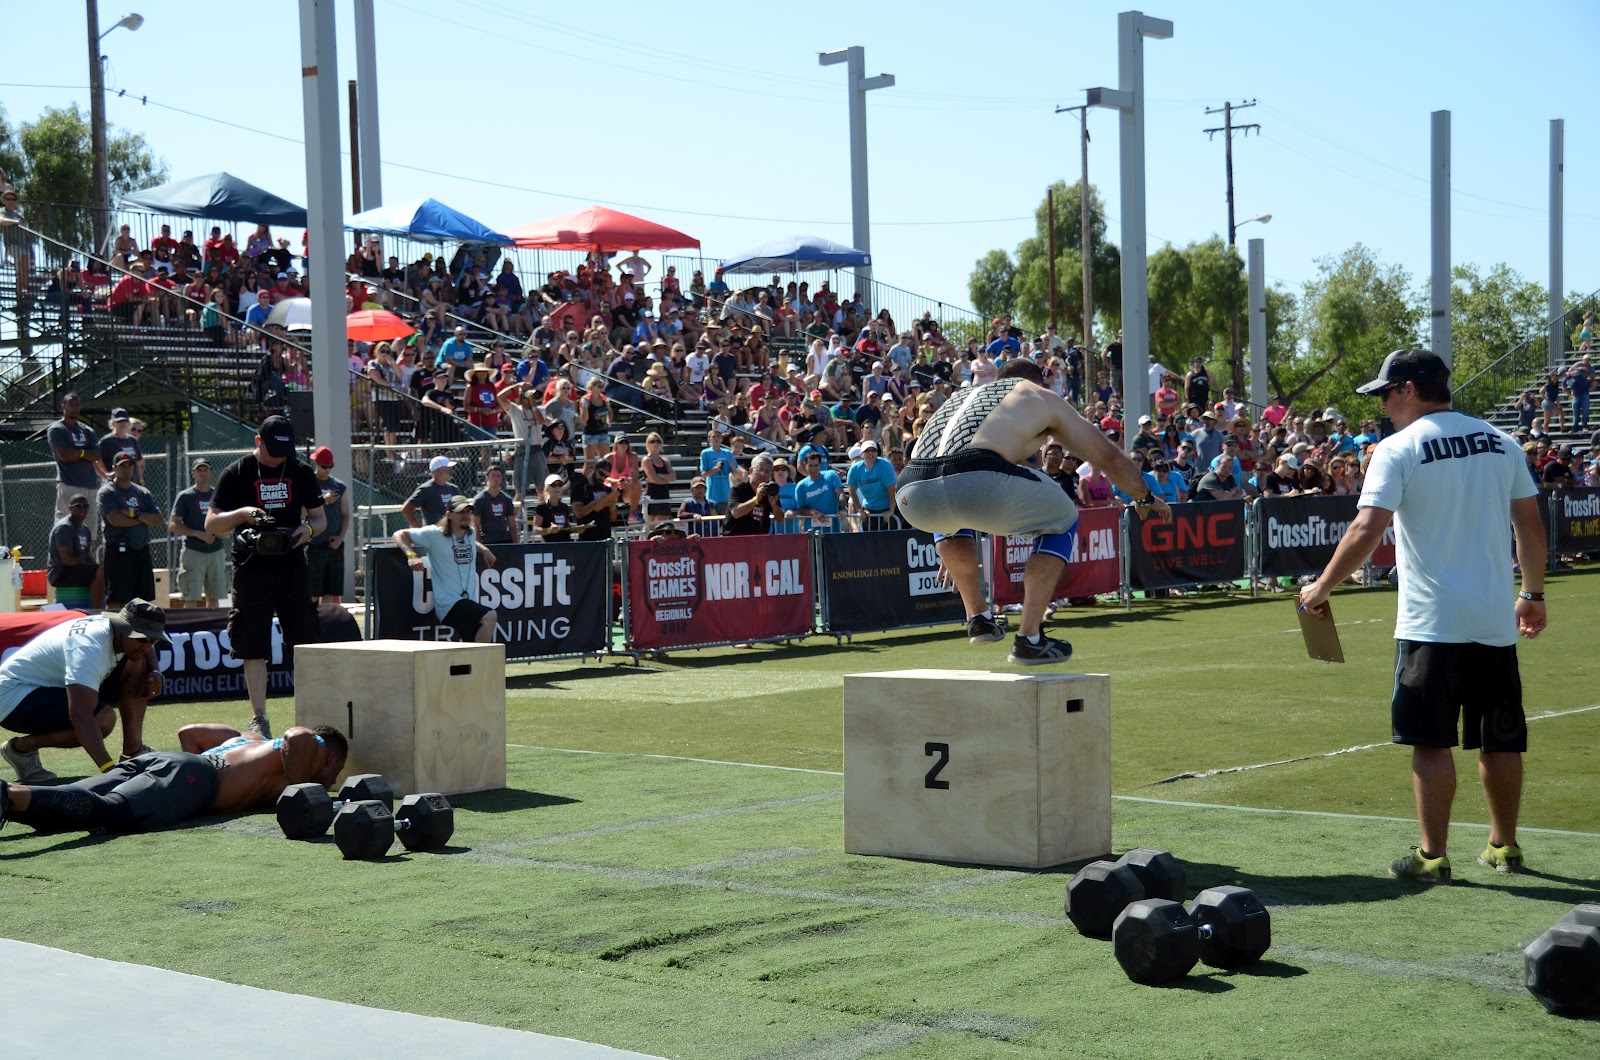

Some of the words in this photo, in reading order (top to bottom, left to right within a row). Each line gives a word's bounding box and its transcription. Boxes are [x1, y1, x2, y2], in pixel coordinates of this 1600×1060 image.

[1421, 431, 1506, 465] JUDGE
[260, 483, 287, 492] CrossFit
[261, 491, 288, 500] GAMES
[806, 484, 829, 499] Reebok
[1141, 513, 1236, 553] GNC
[1267, 515, 1352, 549] CrossFit.co
[1570, 520, 1583, 537] FOR
[648, 557, 696, 578] CrossFit
[1153, 556, 1183, 571] LIVE
[1189, 552, 1224, 567] WELL
[832, 569, 873, 580] KNOWLEDGE
[880, 567, 901, 577] POWER
[649, 578, 697, 600] GAMES
[655, 608, 693, 621] REGIONALS
[347, 701, 354, 740] 1
[924, 741, 950, 790] 2
